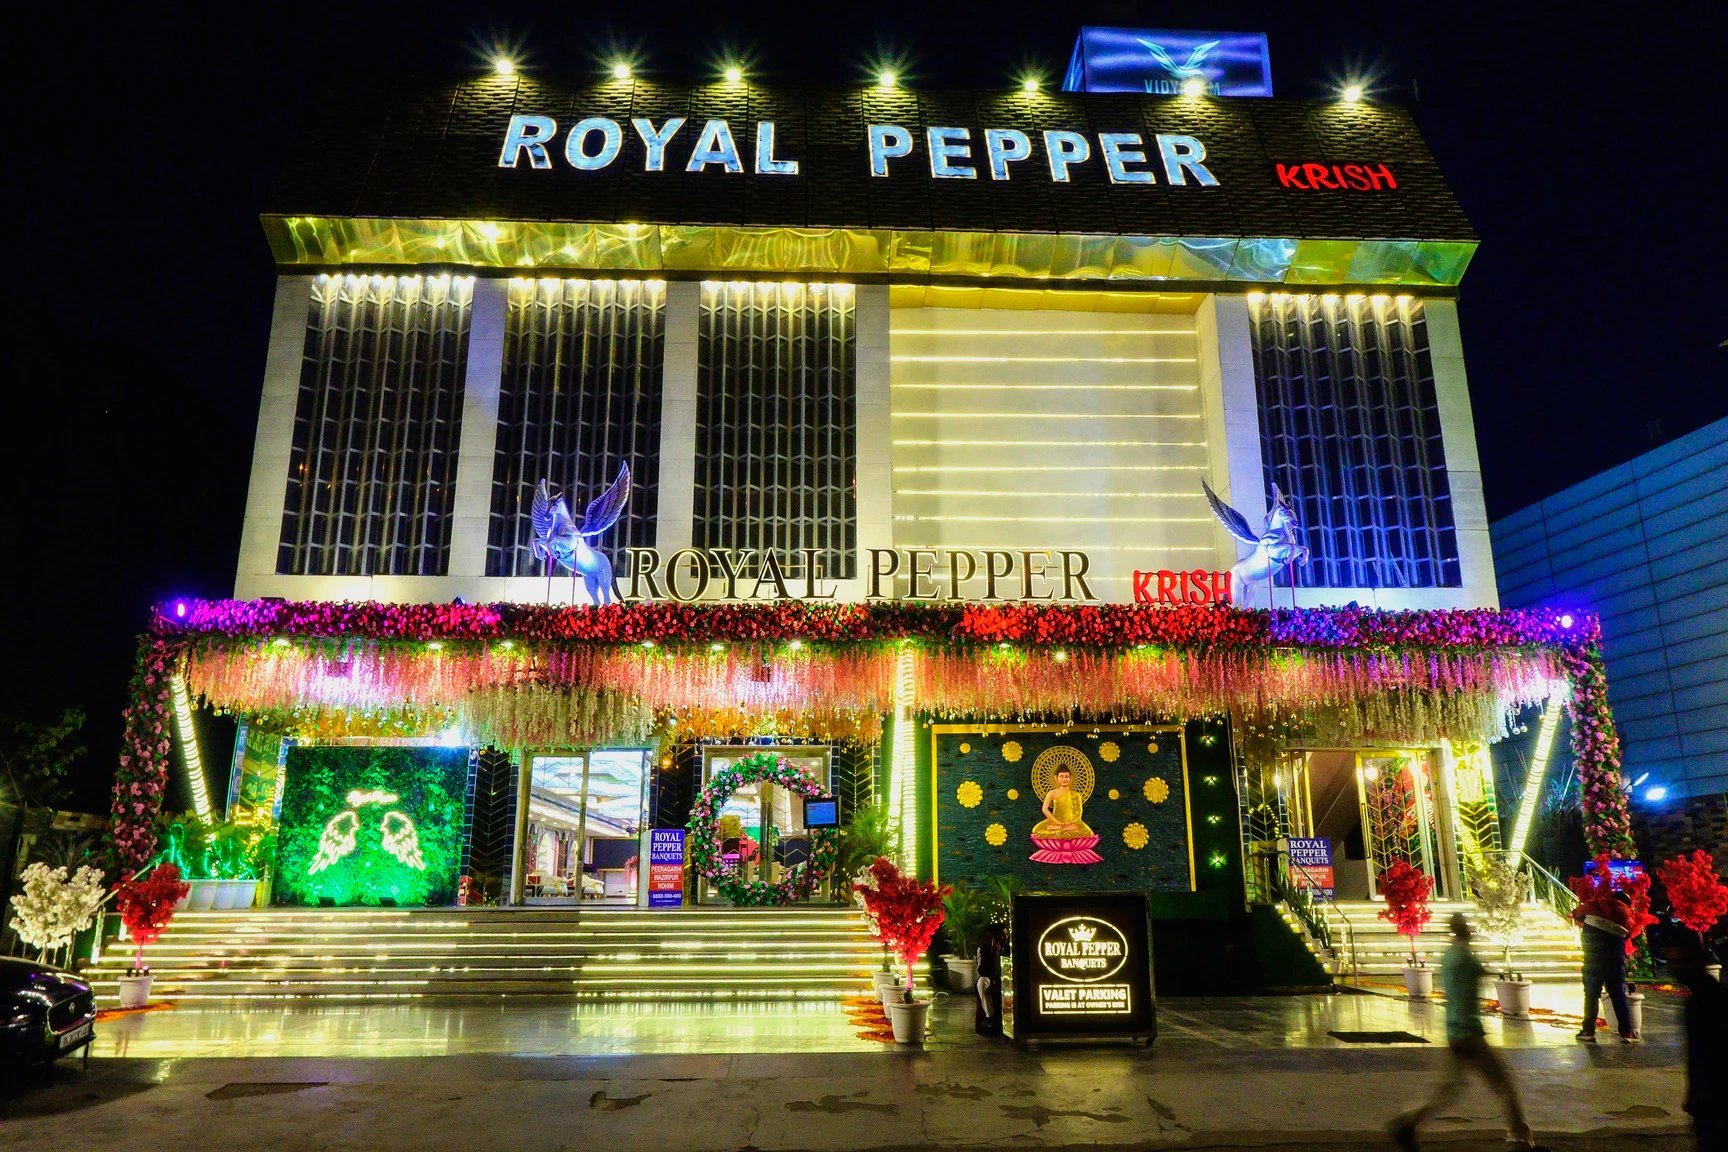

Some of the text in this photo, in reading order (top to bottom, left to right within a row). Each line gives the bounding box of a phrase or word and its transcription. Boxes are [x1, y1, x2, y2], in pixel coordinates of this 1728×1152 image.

[498, 115, 1222, 187] ROYAL PEPPER
[1275, 163, 1398, 192] KRISH
[624, 547, 1101, 602] ROYAL PEPPER
[1132, 569, 1233, 606] KRISH
[655, 832, 681, 841] ROYAL
[653, 843, 681, 851] PEPPER
[652, 853, 682, 861] BANQUETS
[1044, 941, 1122, 956] ROYAL PEPPER
[1061, 957, 1107, 970] BANQUETS
[1043, 988, 1127, 1001] VALET PARKING
[1045, 1001, 1071, 1009] PARKING
